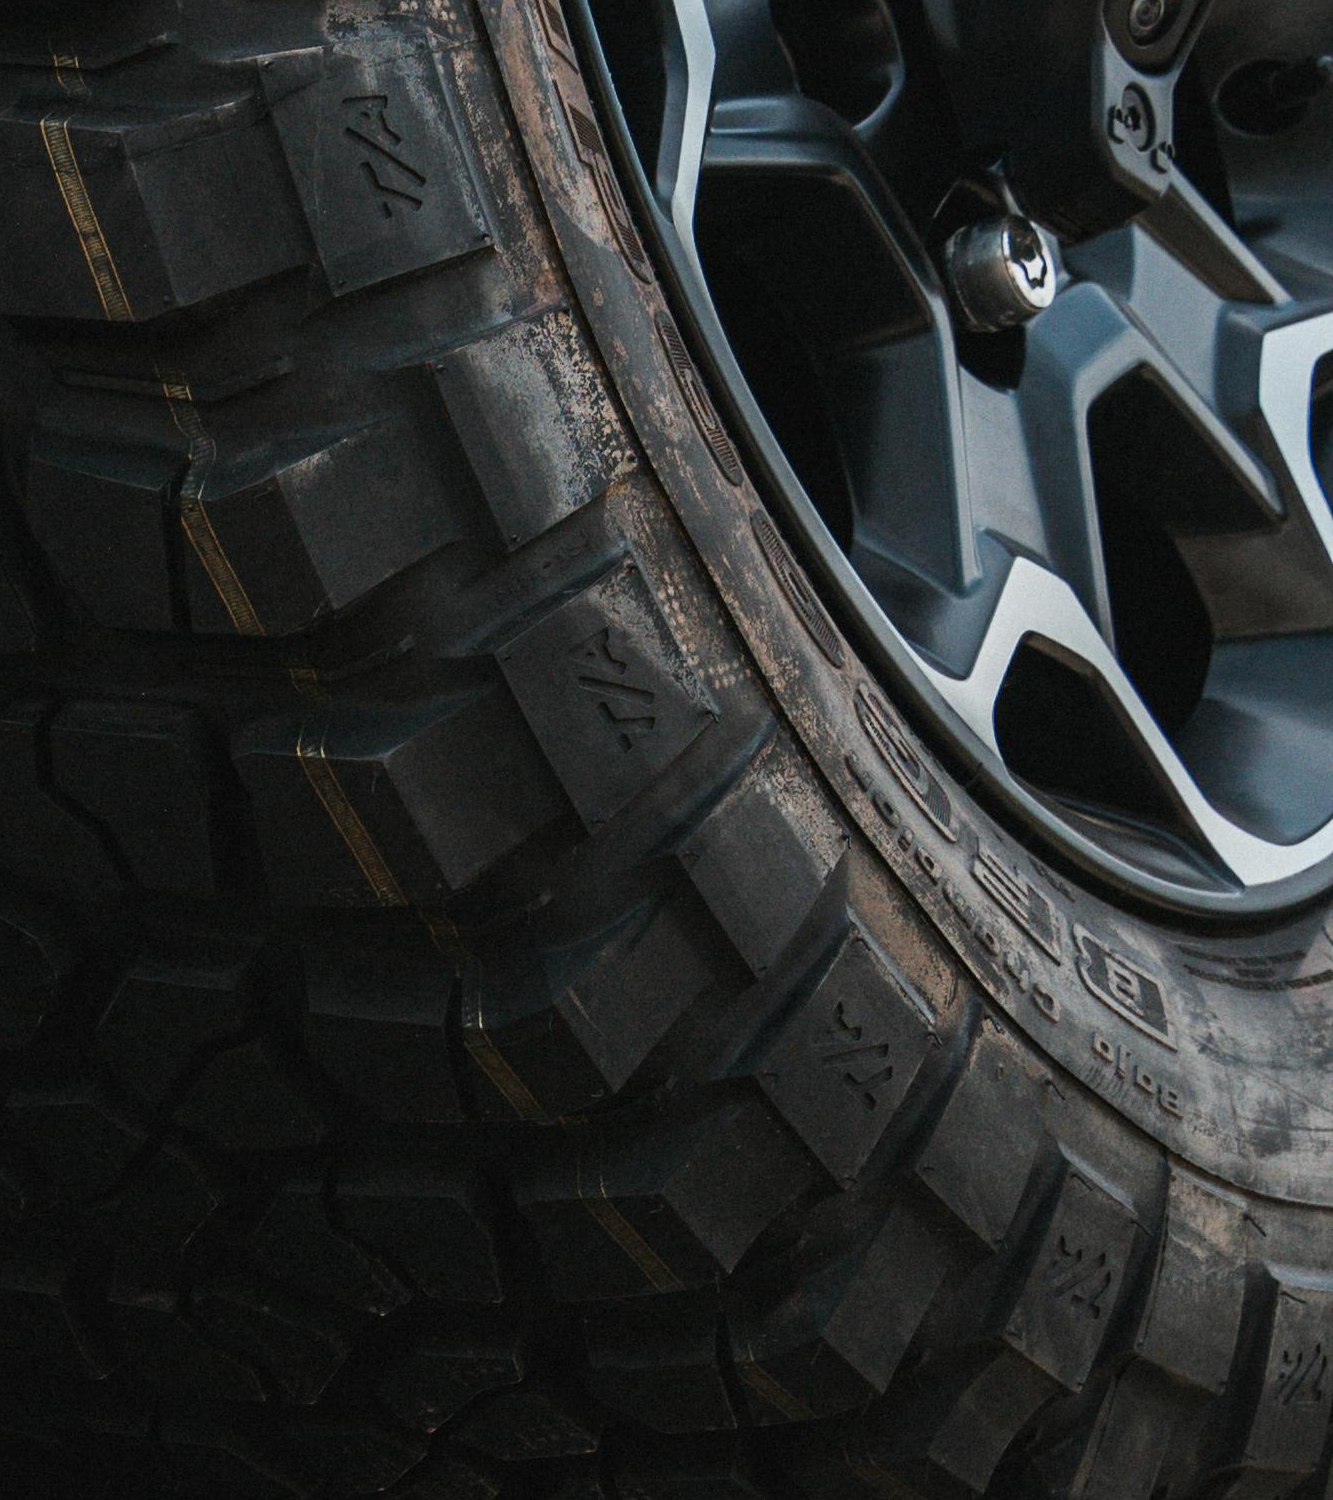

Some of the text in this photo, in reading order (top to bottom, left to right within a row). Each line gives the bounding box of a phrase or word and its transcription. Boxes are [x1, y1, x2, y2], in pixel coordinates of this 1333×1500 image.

[341, 94, 427, 218] T/A
[569, 625, 657, 754] T/A
[821, 1001, 896, 1111] T/A
